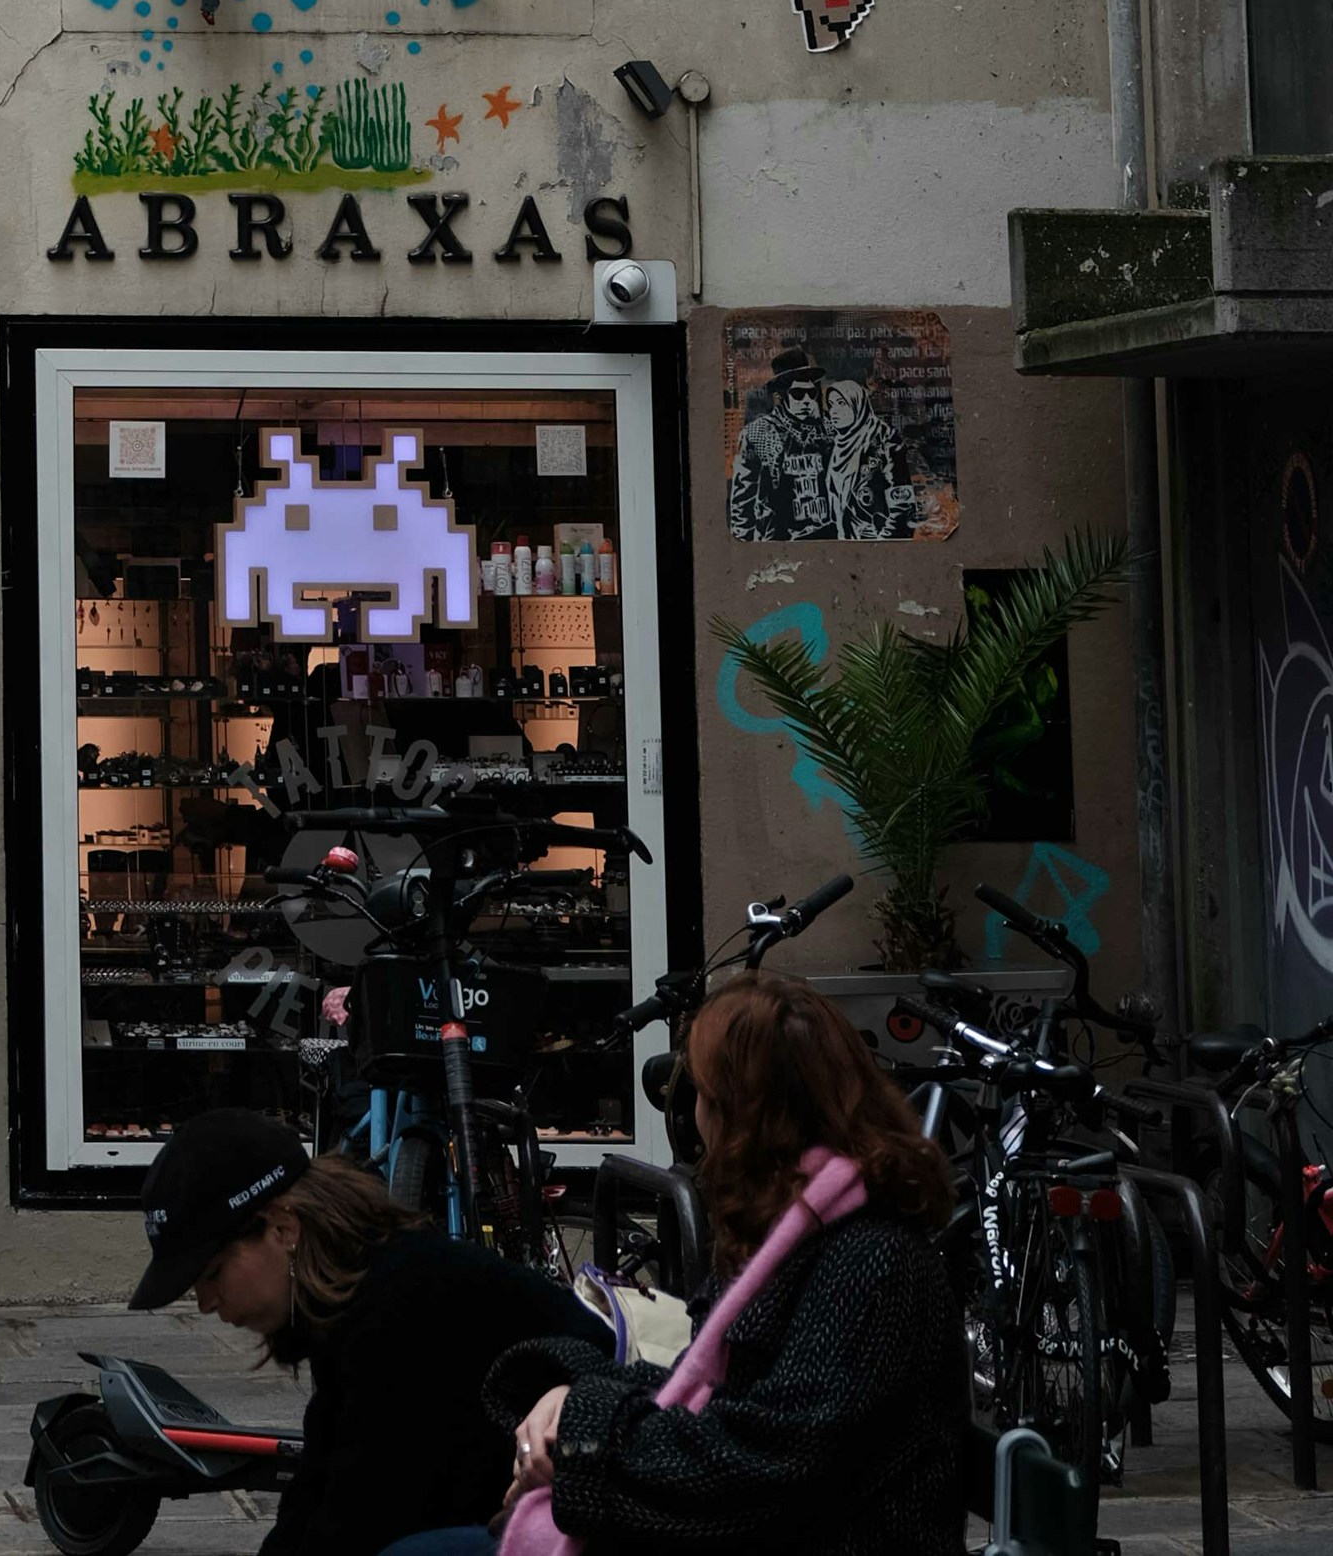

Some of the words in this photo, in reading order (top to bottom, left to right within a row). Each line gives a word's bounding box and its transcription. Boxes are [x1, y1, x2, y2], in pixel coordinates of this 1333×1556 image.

[45, 191, 635, 264] ABRAXAS
[899, 366, 925, 379] pace
[229, 1190, 251, 1210] RED
[249, 1173, 275, 1197] STAR
[272, 1165, 286, 1180] FC
